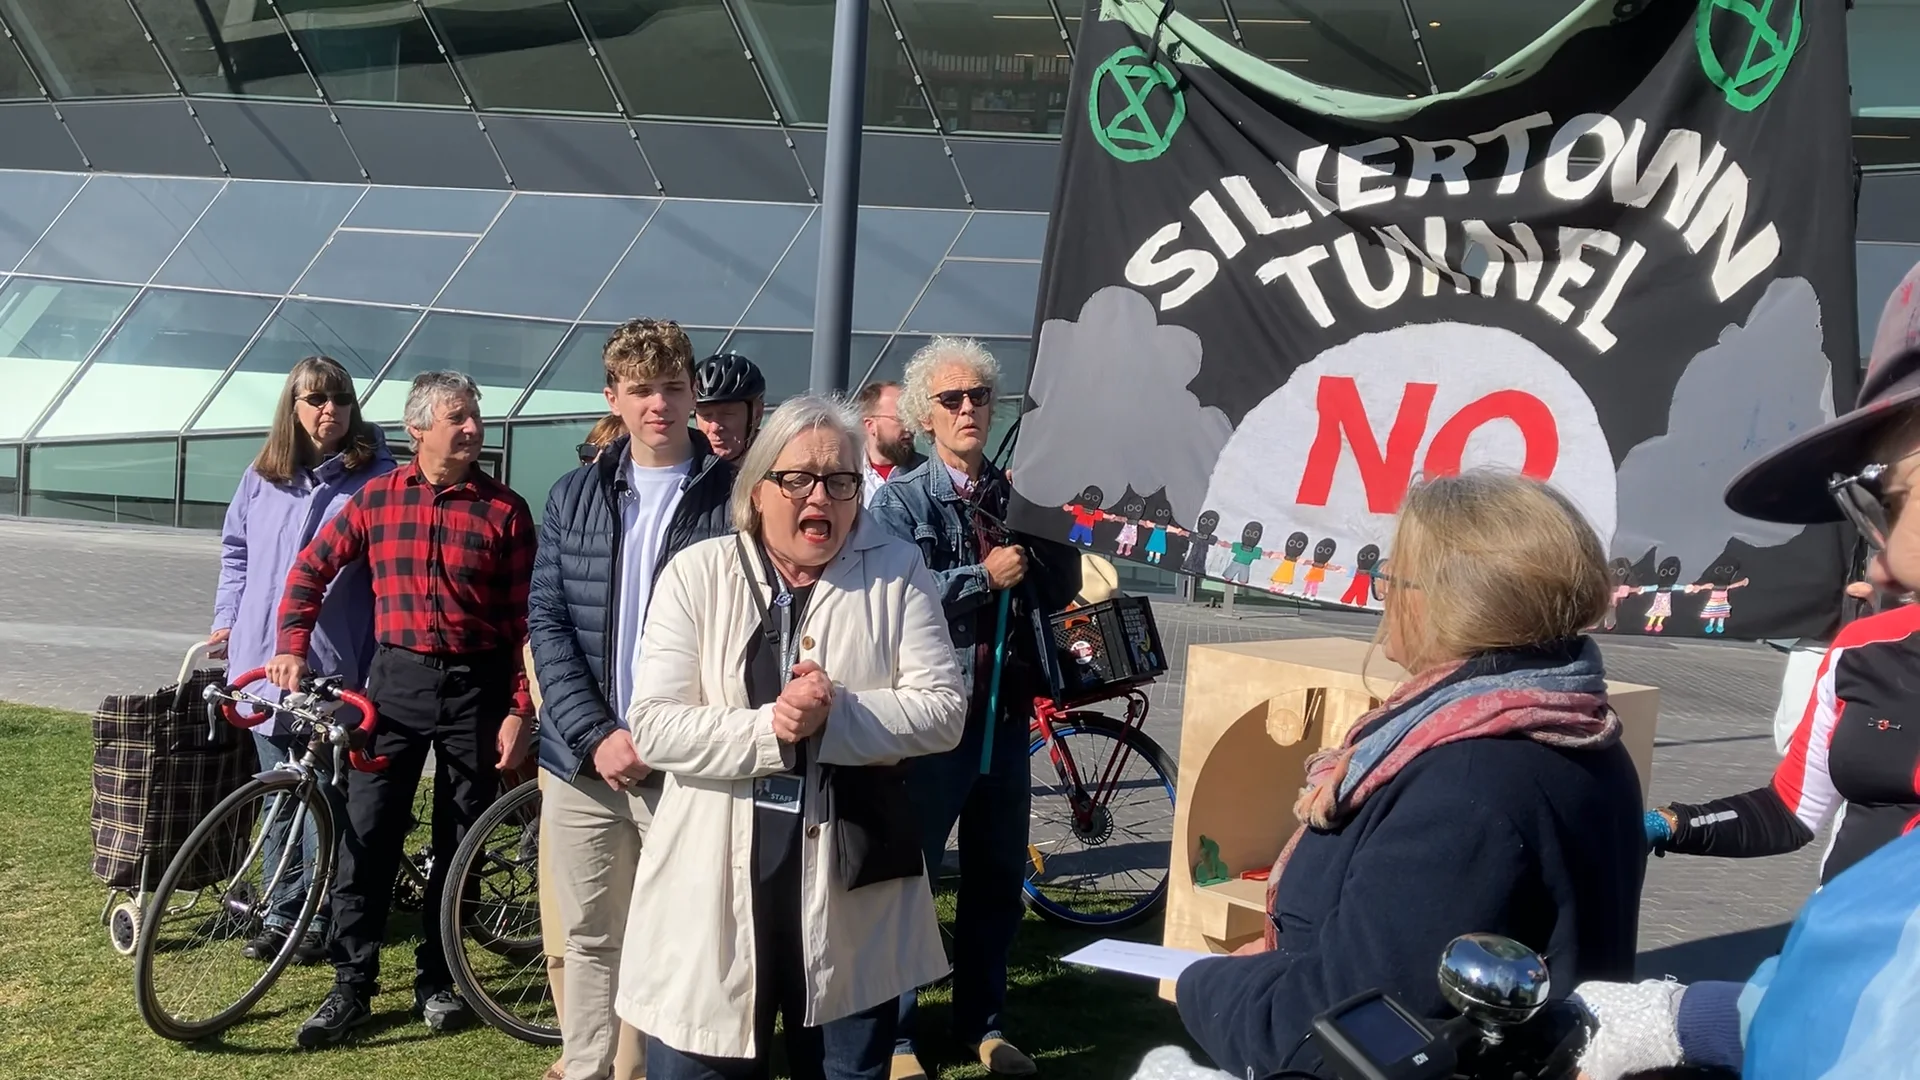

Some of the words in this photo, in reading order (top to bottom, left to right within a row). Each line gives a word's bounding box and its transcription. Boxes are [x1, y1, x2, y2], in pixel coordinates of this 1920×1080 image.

[1125, 111, 1780, 312] SILVERTOWN
[1255, 216, 1646, 353] TUNNEL
[1295, 375, 1560, 514] NO
[771, 793, 793, 801] STAFF
